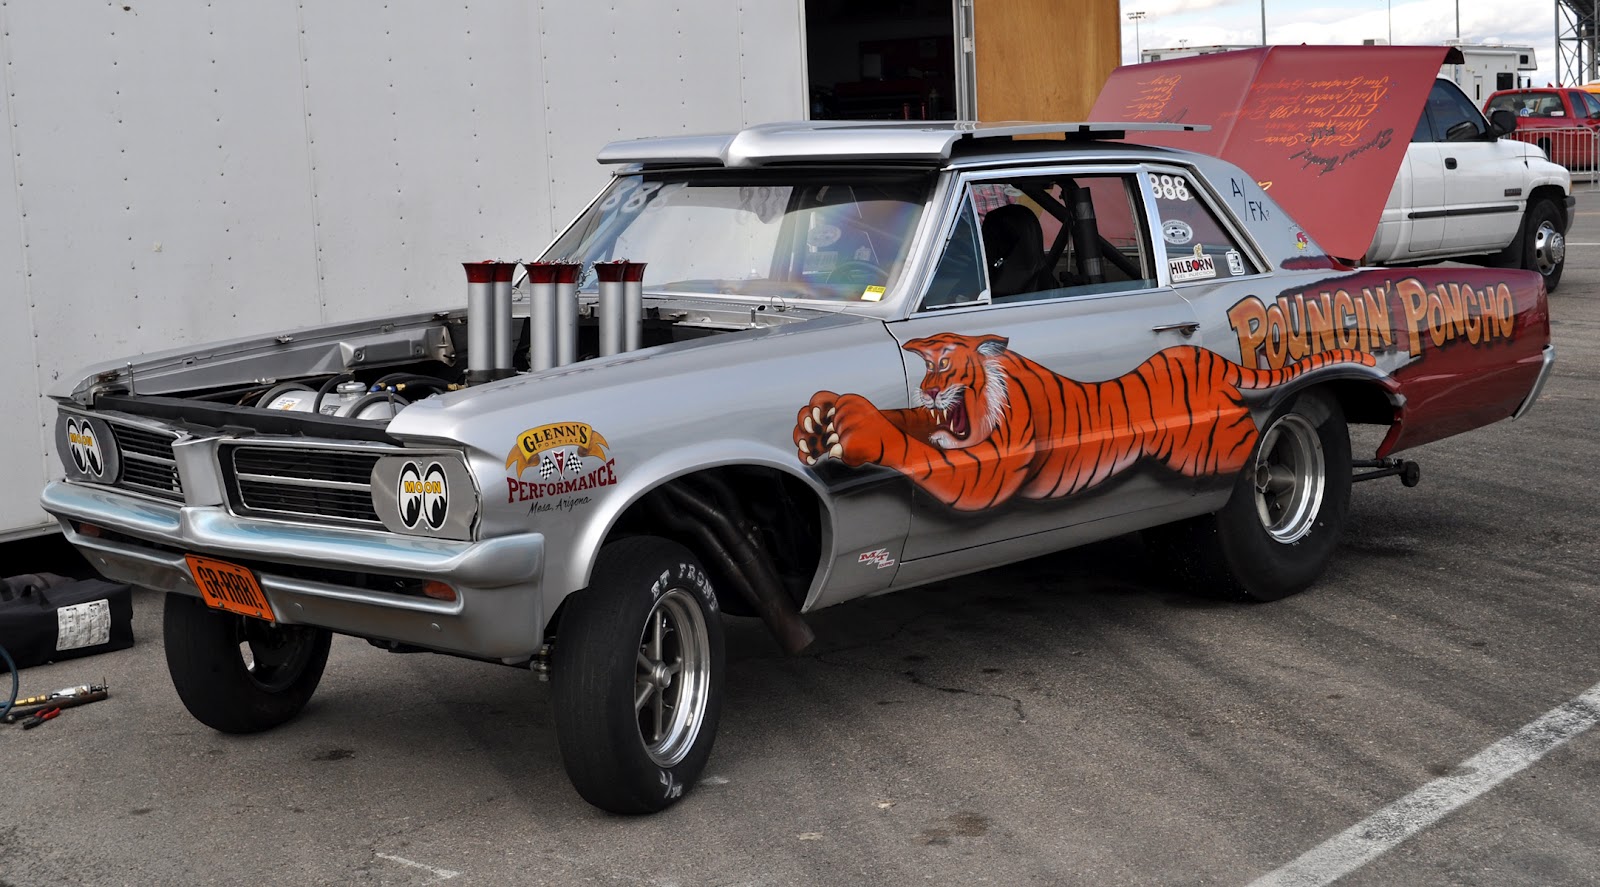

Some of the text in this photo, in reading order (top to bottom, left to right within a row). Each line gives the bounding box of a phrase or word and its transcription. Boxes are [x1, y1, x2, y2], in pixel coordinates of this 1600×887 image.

[1149, 173, 1189, 201] 888
[1169, 257, 1214, 275] HILBORN
[1396, 277, 1515, 359] PONCHO
[70, 432, 93, 447] MOON
[523, 424, 588, 453] GLENN'S
[538, 438, 580, 448] PONTIAC
[404, 480, 442, 494] MOON
[506, 457, 617, 504] PERFORMANCE
[555, 496, 593, 512] Arizona
[679, 563, 719, 612] FRONT
